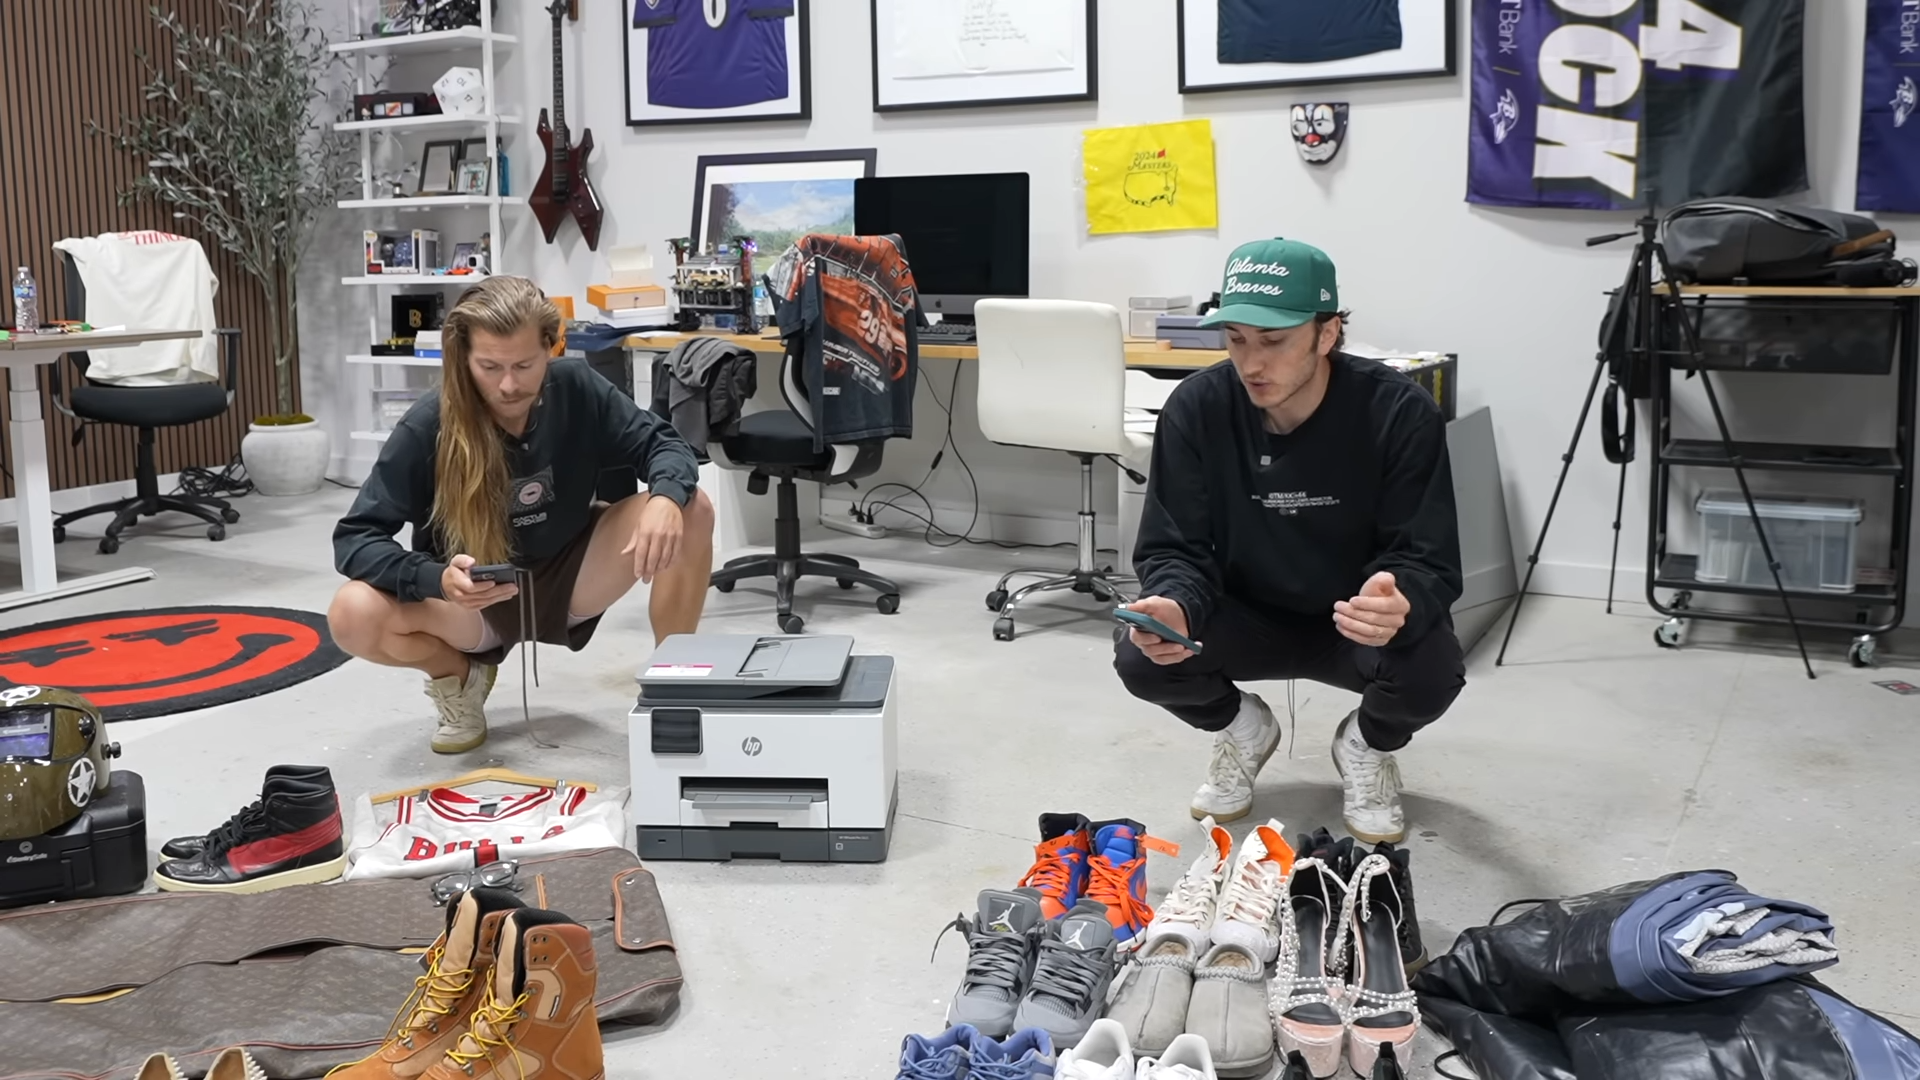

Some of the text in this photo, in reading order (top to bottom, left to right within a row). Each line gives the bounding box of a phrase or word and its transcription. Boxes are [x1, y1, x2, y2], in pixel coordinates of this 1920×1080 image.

[1499, 10, 1520, 55] Bank
[1900, 11, 1920, 54] Bank
[1532, 0, 1642, 199] CK
[1134, 151, 1157, 161] 2024
[1226, 256, 1290, 277] Atlanta
[1224, 276, 1284, 296] Braves
[743, 737, 762, 756] hp
